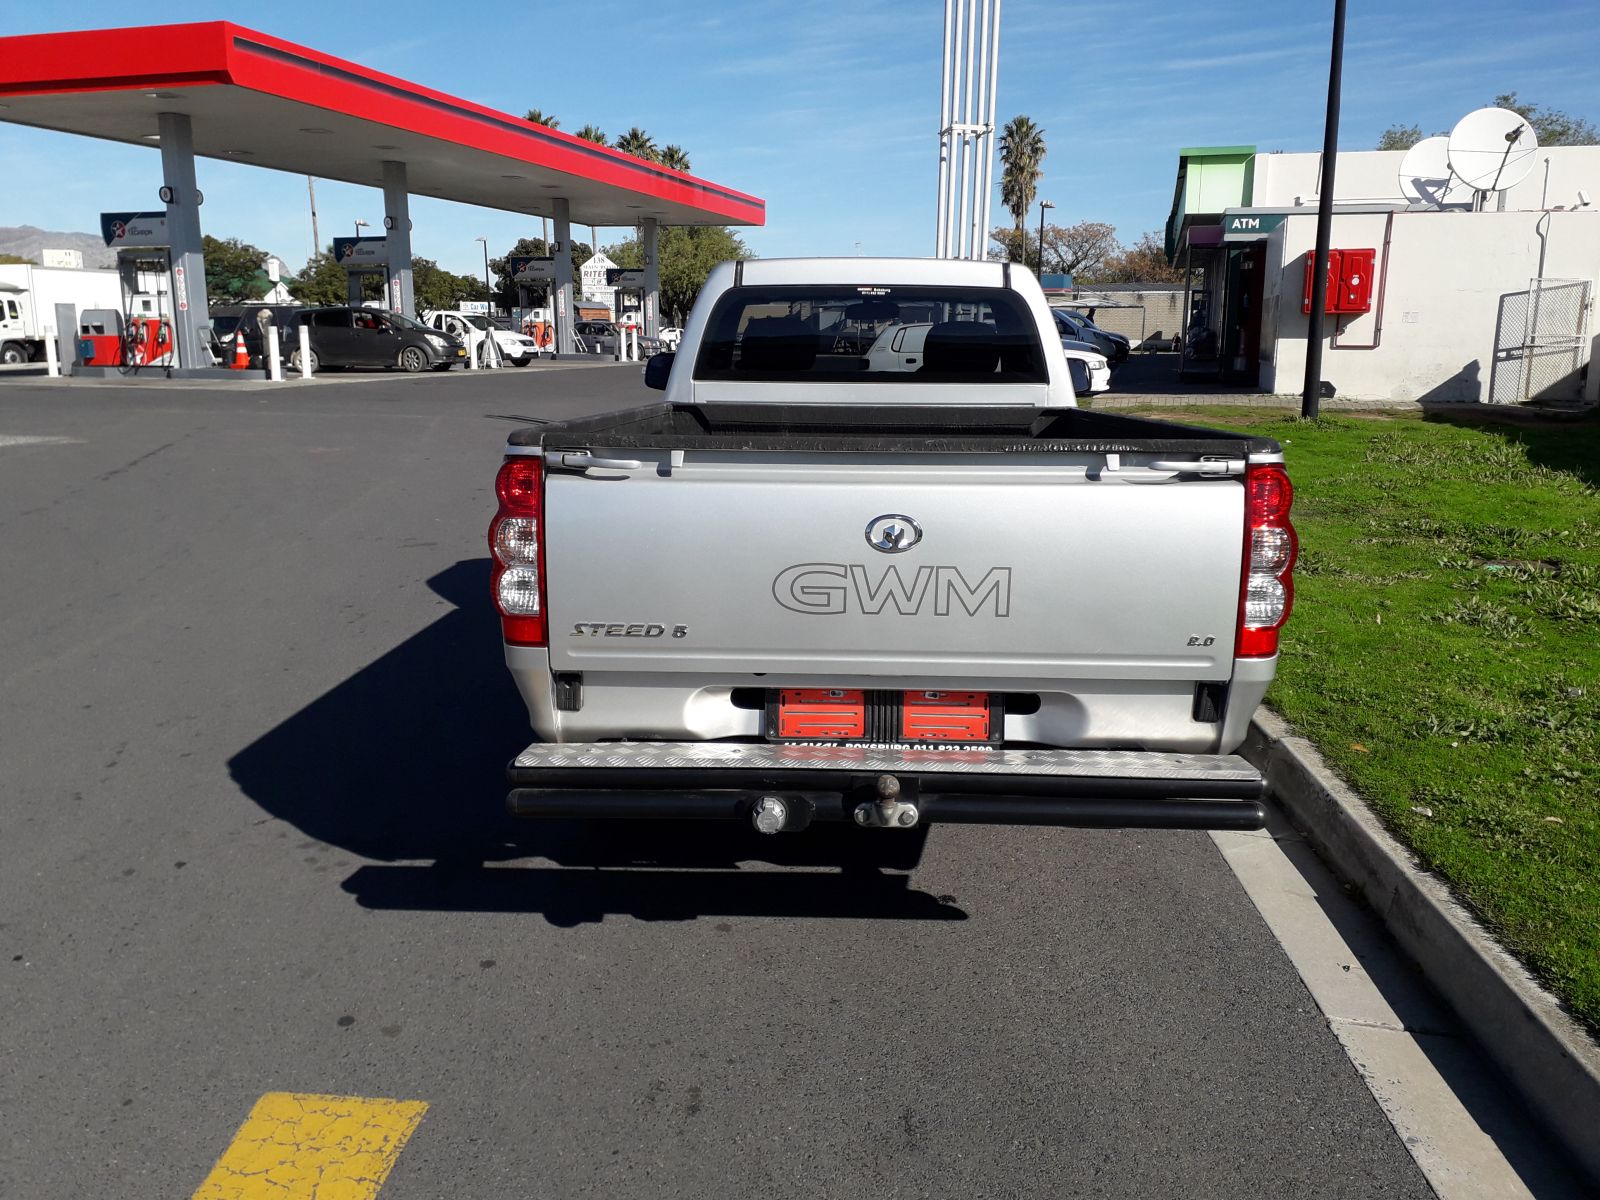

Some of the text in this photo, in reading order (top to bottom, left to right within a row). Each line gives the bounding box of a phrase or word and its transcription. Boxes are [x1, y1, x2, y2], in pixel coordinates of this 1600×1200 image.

[1231, 218, 1260, 229] ATM
[593, 256, 605, 264] 138
[772, 562, 1012, 617] GWM
[569, 622, 665, 638] STEED
[1187, 634, 1216, 647] 2.0
